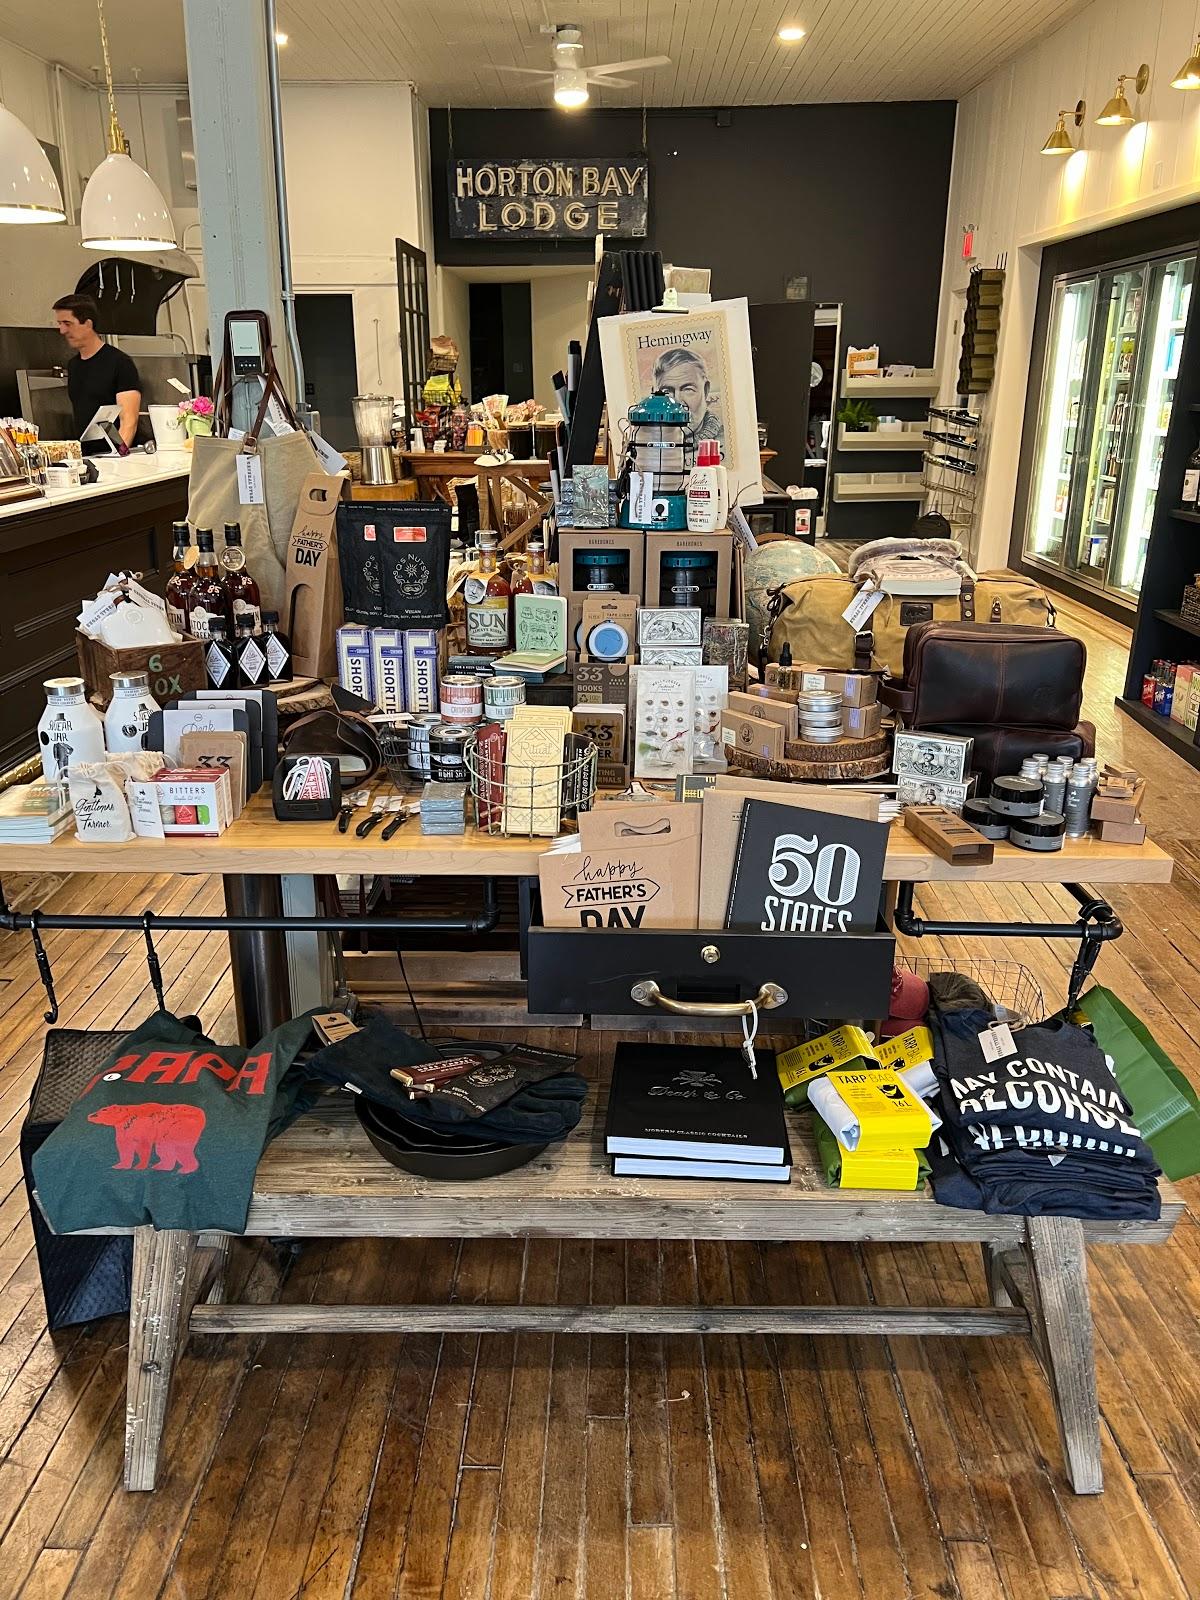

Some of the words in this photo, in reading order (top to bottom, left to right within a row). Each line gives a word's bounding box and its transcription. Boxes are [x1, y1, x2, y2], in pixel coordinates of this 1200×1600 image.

[456, 166, 573, 197] HORTON
[582, 166, 645, 197] BAY
[478, 202, 619, 232] LODGE
[637, 329, 712, 349] Hemingway
[296, 538, 324, 549] FATHER'S
[295, 548, 321, 567] DAY
[468, 612, 507, 632] SUN
[149, 653, 163, 673] 6
[576, 666, 605, 682] 33
[577, 684, 603, 692] BOOKS
[47, 720, 73, 731] SWEAR
[51, 732, 69, 742] JAR
[169, 787, 206, 795] BITTERS
[573, 855, 644, 881] happy
[768, 834, 861, 906] 50
[576, 885, 647, 902] FATHER'S
[580, 905, 646, 928] DAY
[761, 895, 853, 933] STATES
[829, 1031, 845, 1048] TARP
[902, 1033, 918, 1050] TARP
[837, 1074, 867, 1085] TARP
[869, 1073, 895, 1083] BAG
[1006, 1057, 1125, 1114] CONTAIN
[647, 1086, 698, 1098] Death
[960, 1080, 1141, 1137] ALCOHOL
[676, 1129, 706, 1137] CLASSIC
